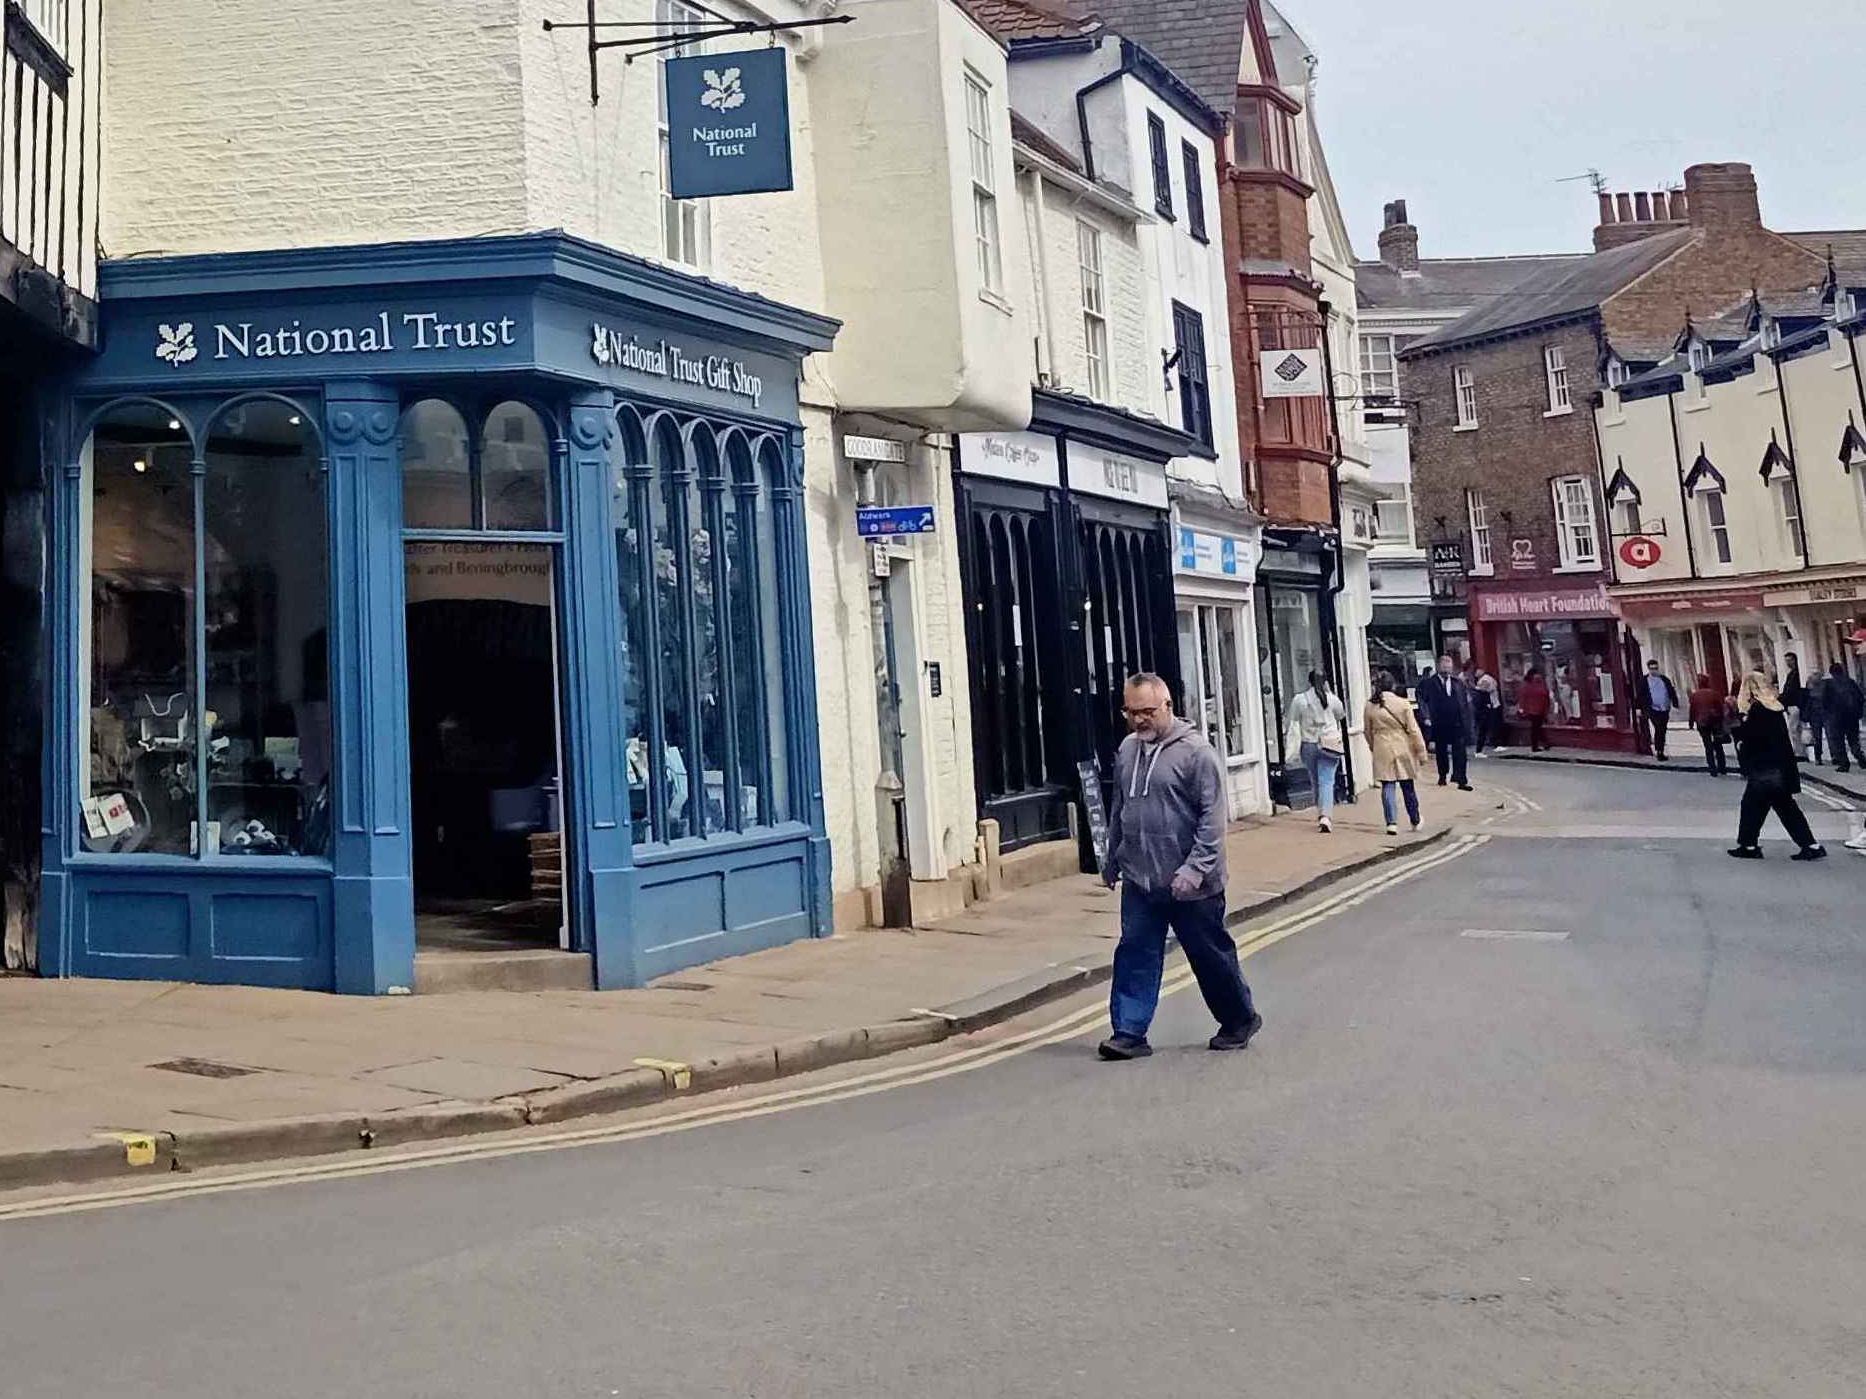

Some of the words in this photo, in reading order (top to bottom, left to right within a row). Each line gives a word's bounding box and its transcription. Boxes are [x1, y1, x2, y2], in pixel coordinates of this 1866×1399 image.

[692, 122, 757, 142] National
[705, 142, 745, 157] Trust
[213, 311, 395, 359] National
[403, 312, 516, 350] Trust
[609, 330, 667, 375] National
[670, 346, 704, 385] Trust
[707, 355, 731, 391] Gift
[733, 362, 762, 408] Shop
[427, 562, 453, 575] and
[1485, 598, 1519, 614] British
[1520, 597, 1548, 613] Heart
